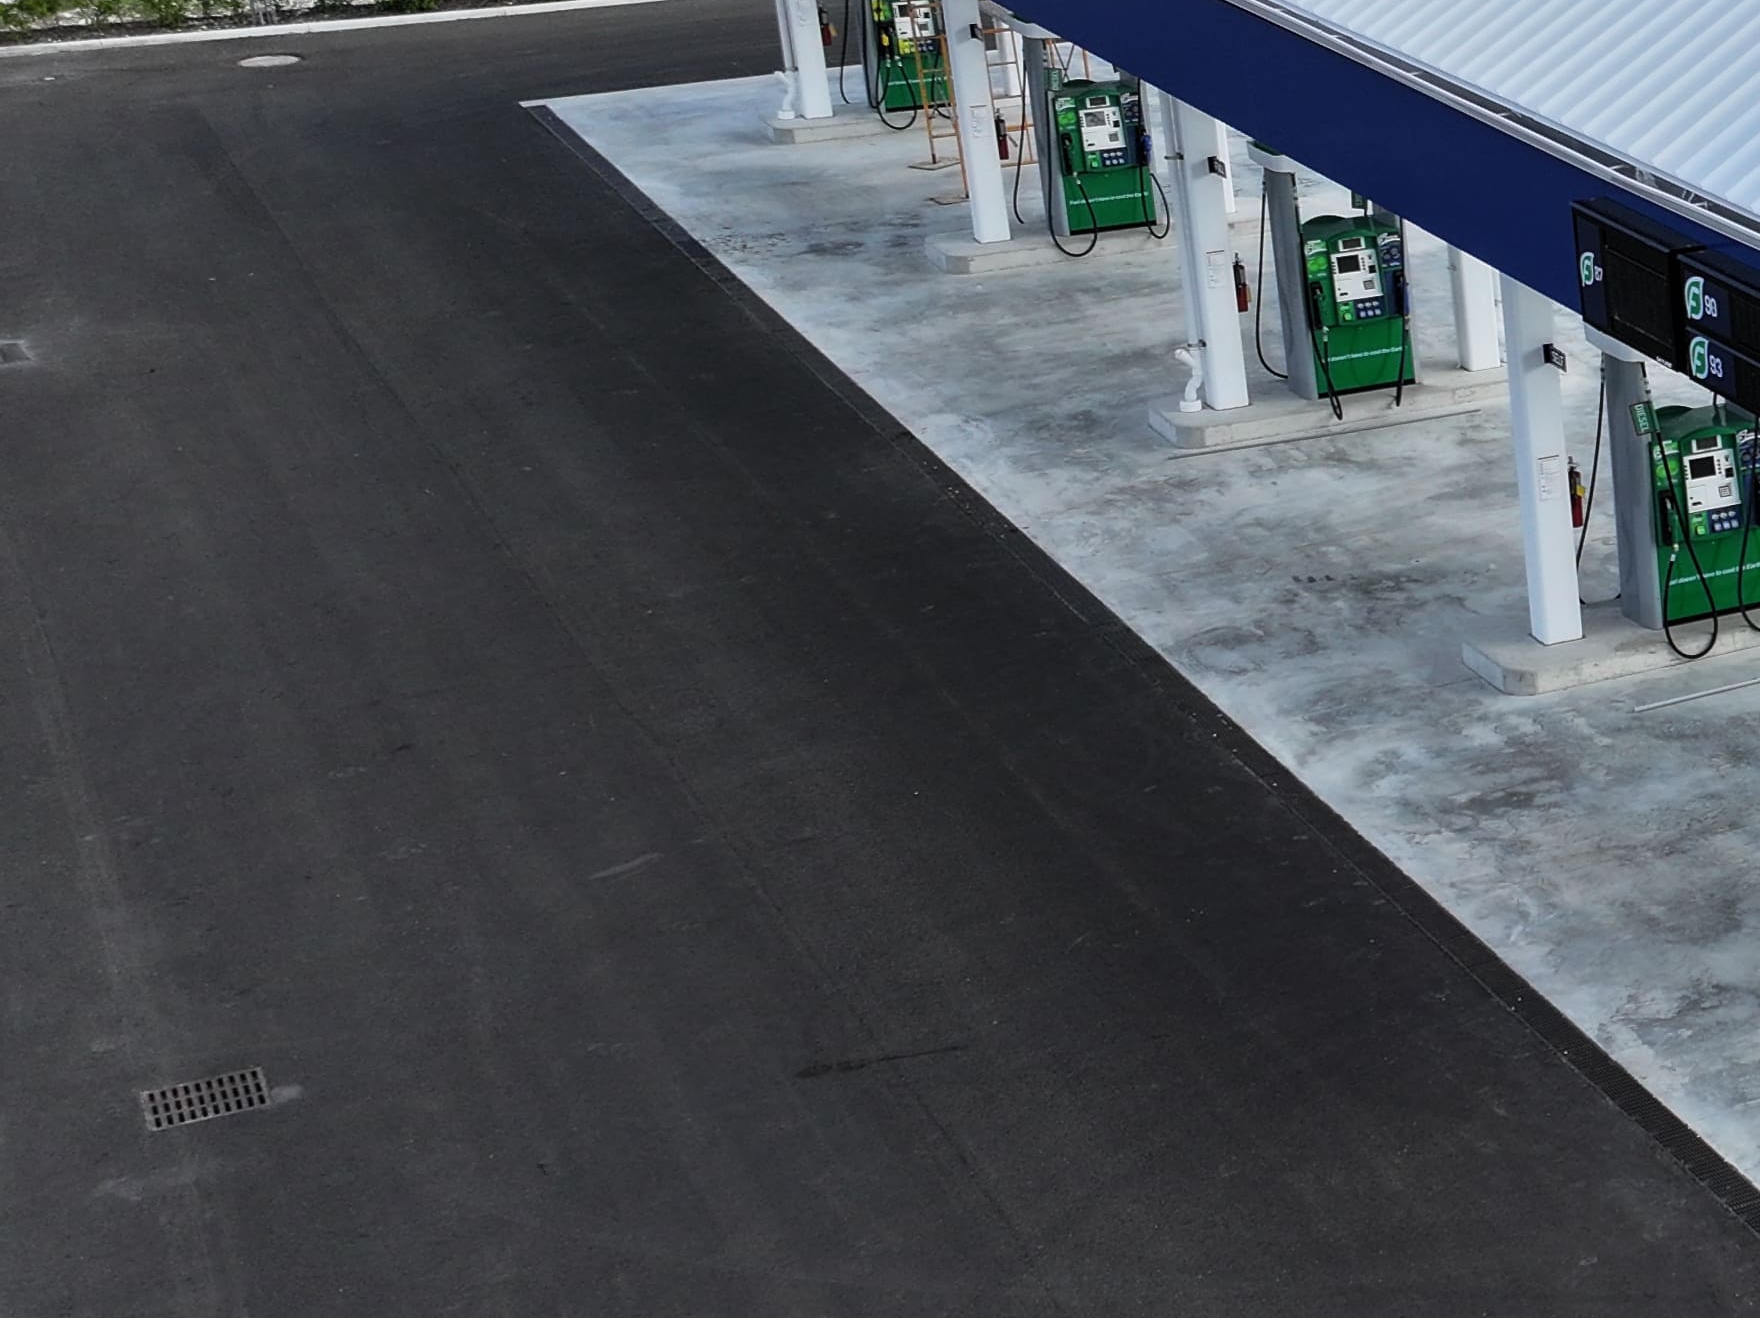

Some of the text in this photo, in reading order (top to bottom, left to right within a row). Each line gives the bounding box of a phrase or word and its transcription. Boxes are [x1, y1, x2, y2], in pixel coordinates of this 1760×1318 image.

[1594, 266, 1603, 281] 87
[1705, 295, 1717, 317] 90
[1709, 355, 1723, 377] 93
[1634, 403, 1650, 433] DIESEL
